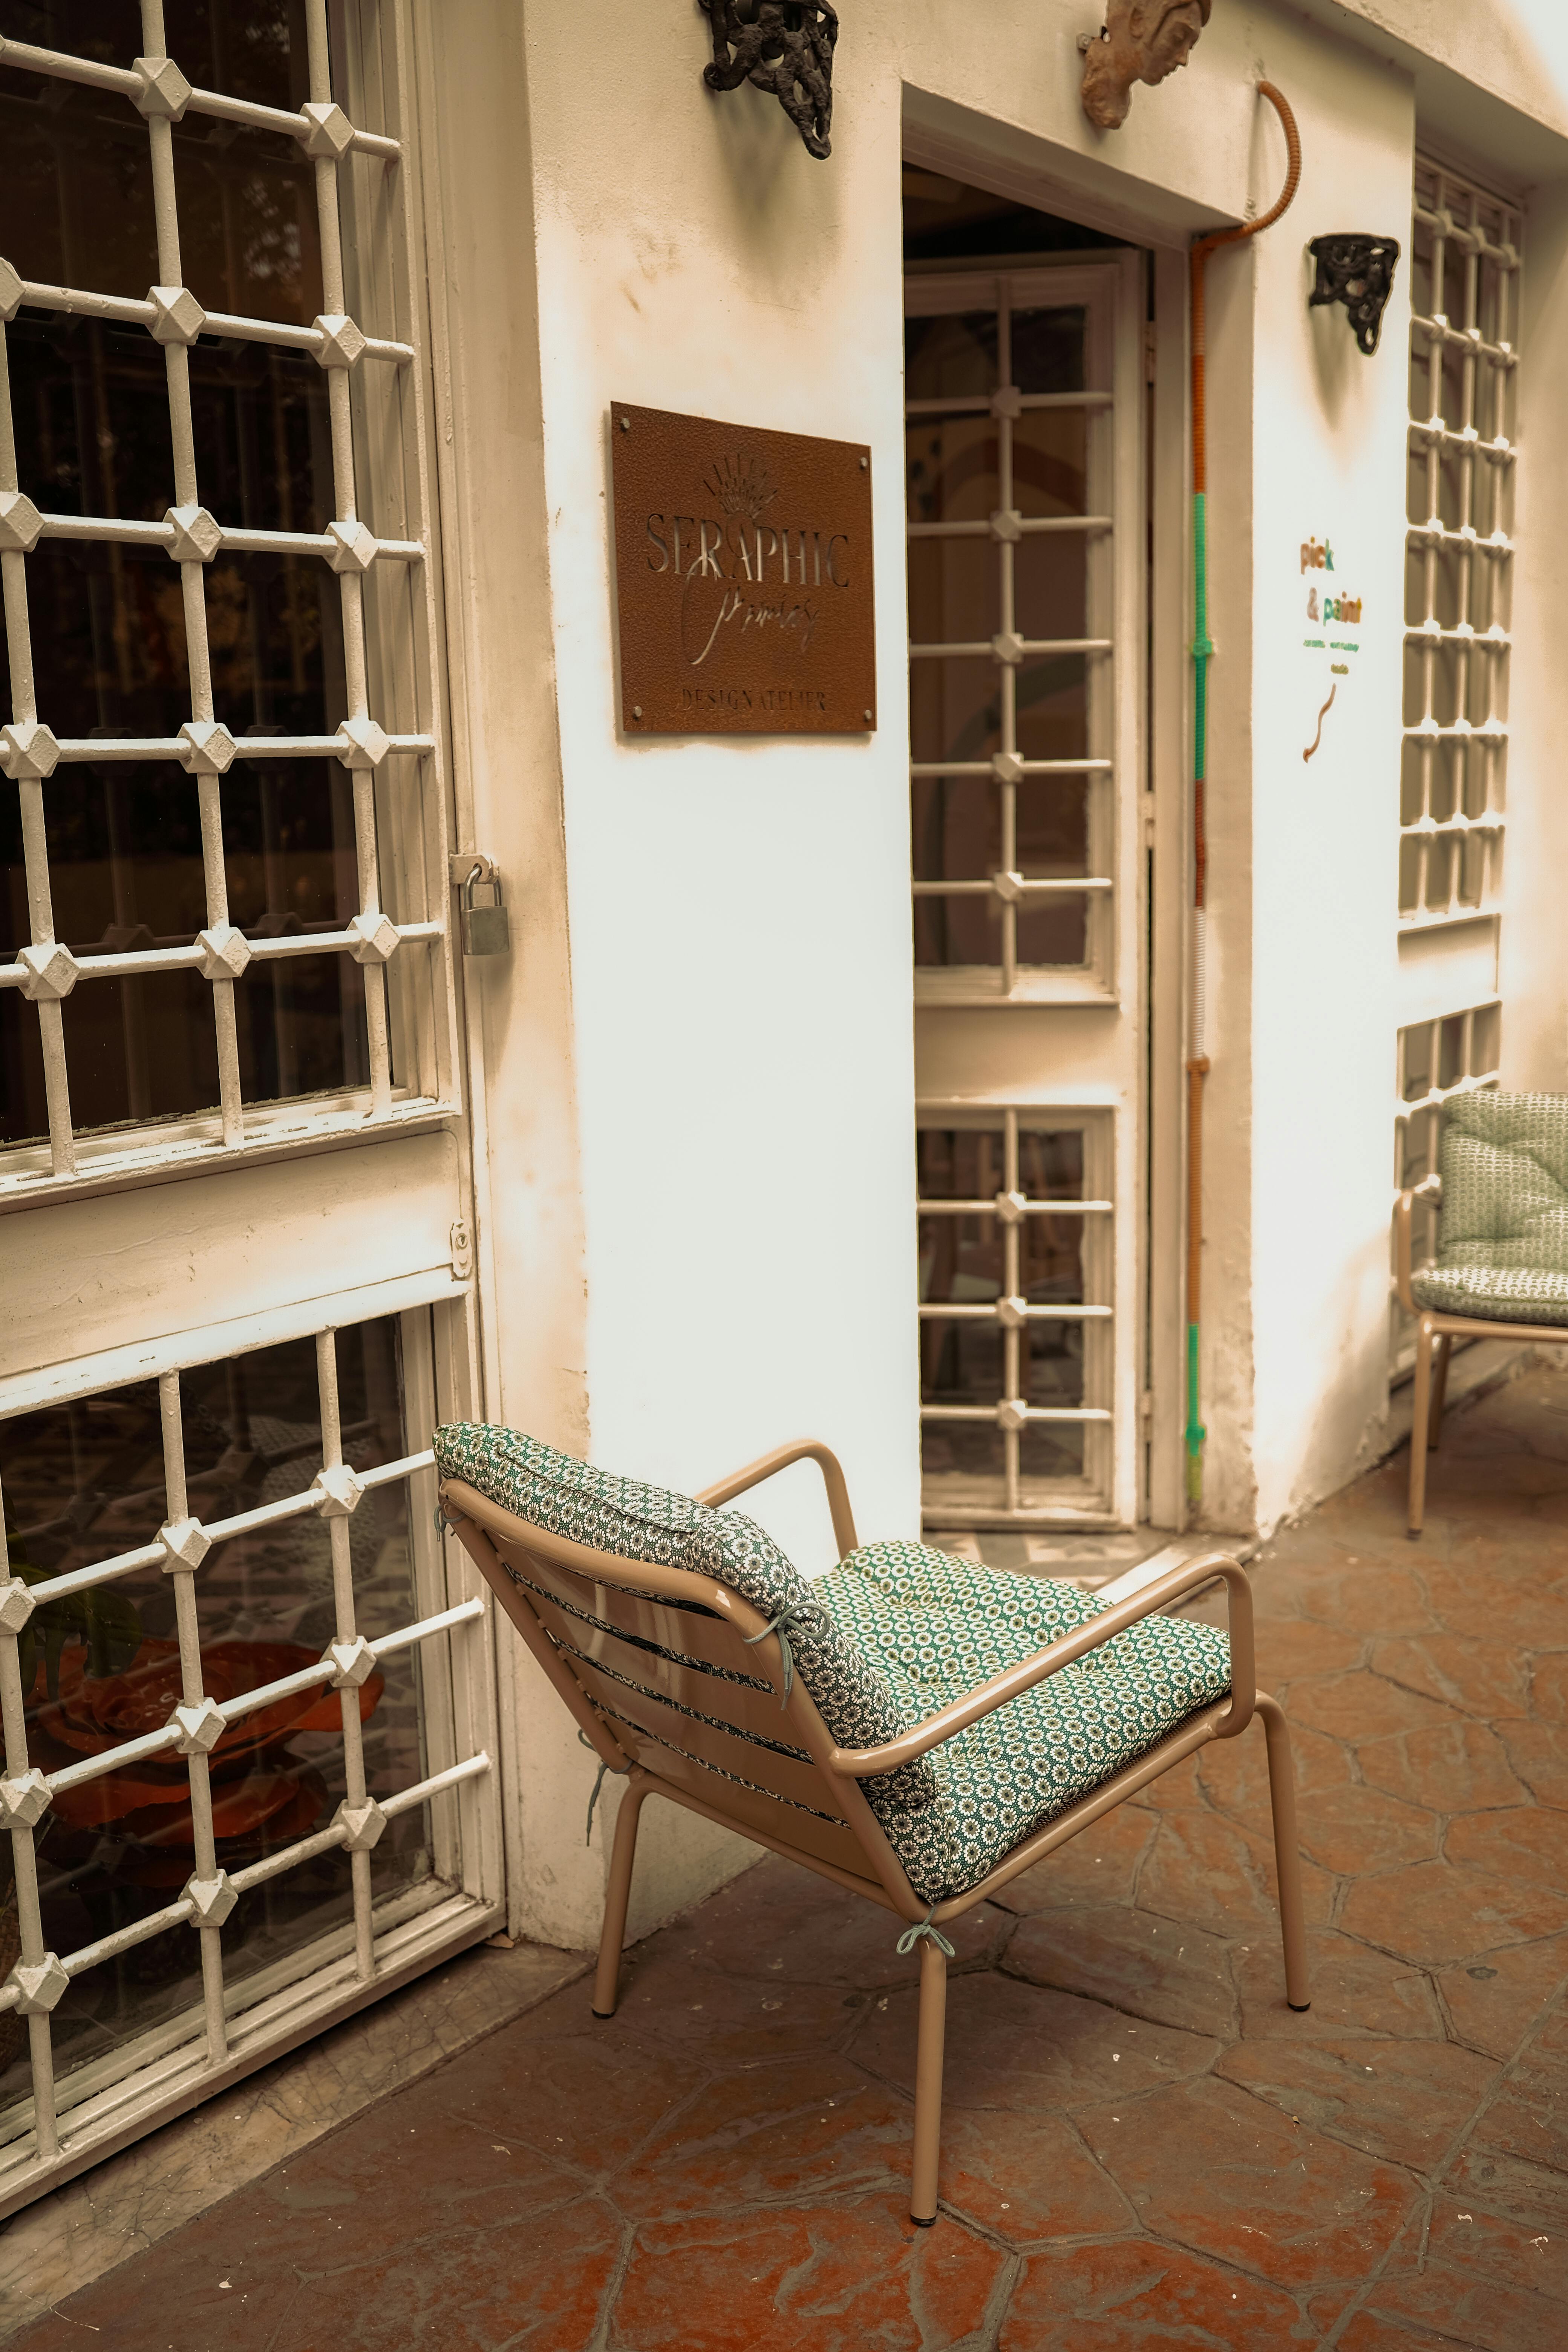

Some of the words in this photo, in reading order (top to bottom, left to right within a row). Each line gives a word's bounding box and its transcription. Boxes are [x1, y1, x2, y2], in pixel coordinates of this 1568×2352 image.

[646, 513, 850, 588] SERAPHIC
[1300, 536, 1334, 575] pick
[682, 688, 752, 711] DESIGN
[759, 690, 827, 712] ATELIER
